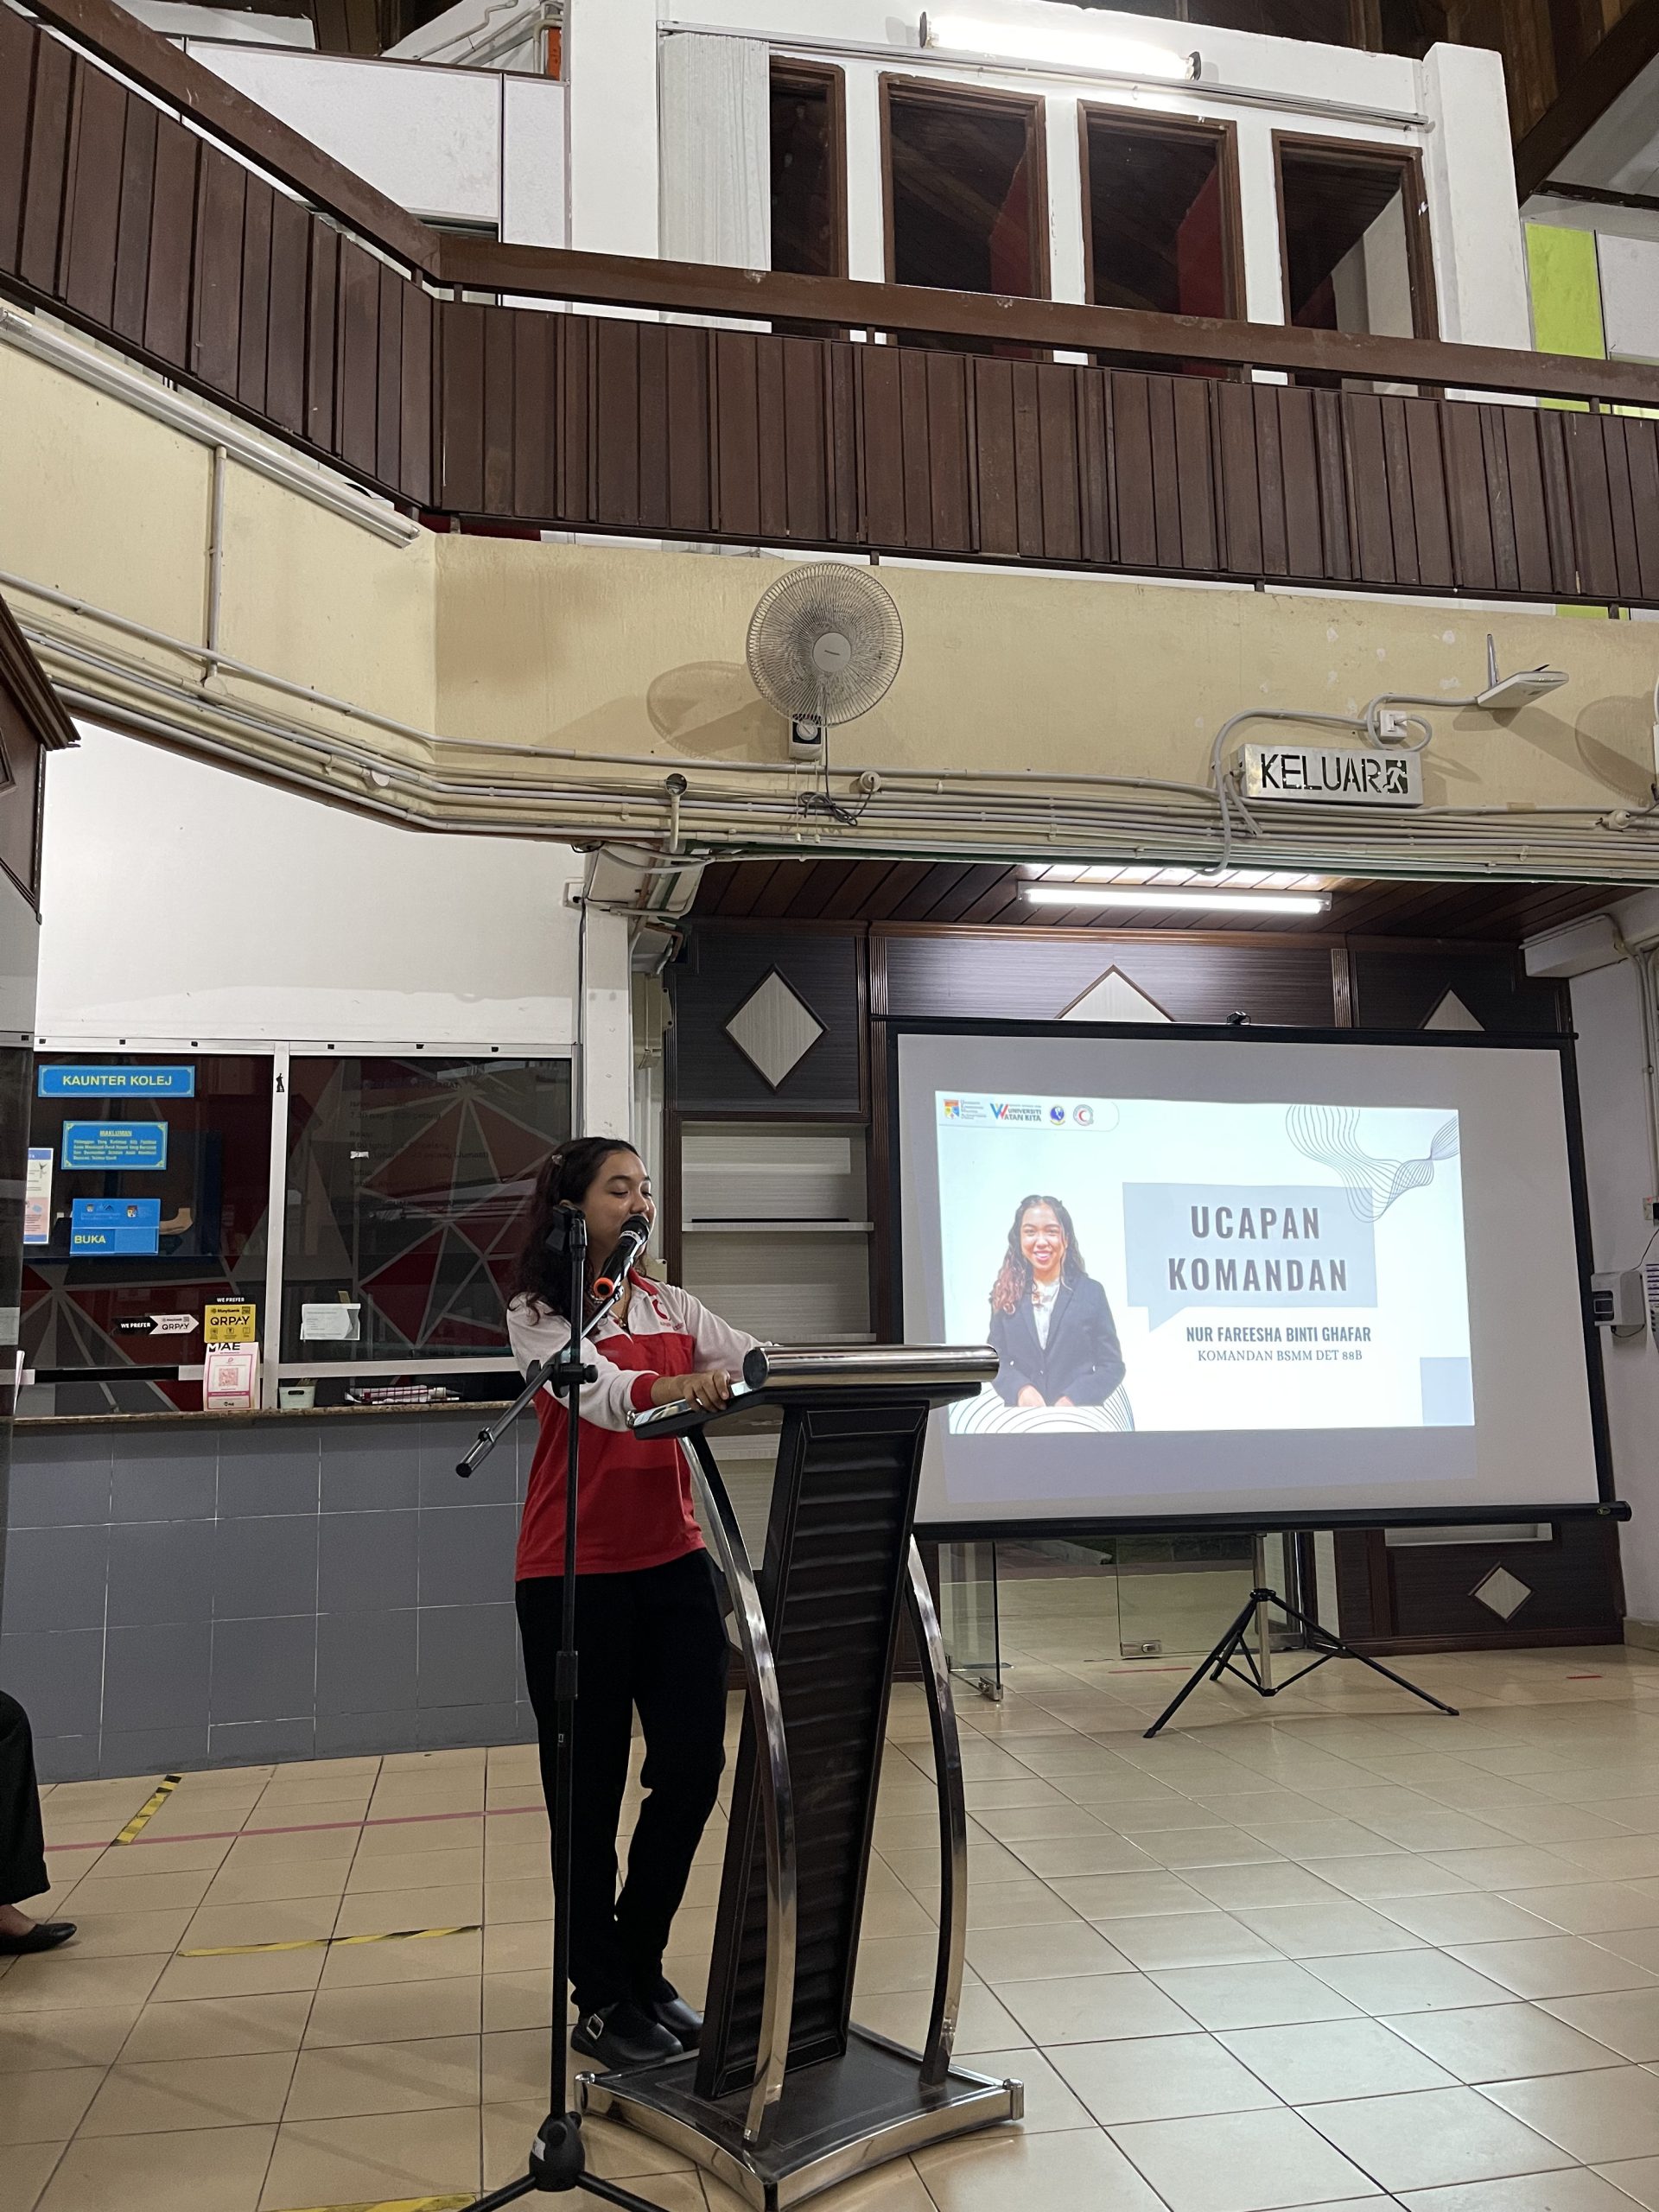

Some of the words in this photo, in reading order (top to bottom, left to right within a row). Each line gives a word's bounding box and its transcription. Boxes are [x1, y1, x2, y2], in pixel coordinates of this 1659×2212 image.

[1261, 753, 1382, 793] KELUAR
[62, 1075, 126, 1085] KAUNTER
[130, 1075, 172, 1086] KOLEJ
[1191, 1205, 1319, 1240] UCAPAN
[74, 1235, 106, 1244] BUKA
[1168, 1257, 1347, 1292] KOMANDAN
[210, 1315, 251, 1326] QRPAY
[1186, 1327, 1213, 1342] NUR
[1217, 1327, 1282, 1342] FAREESHA
[1286, 1327, 1319, 1342] BINTI
[1322, 1326, 1371, 1342] GHAFAR
[1198, 1350, 1274, 1362] KOMANDAN
[1277, 1350, 1314, 1362] BSMM
[1316, 1350, 1339, 1361] DET
[1342, 1350, 1363, 1361] 88B
